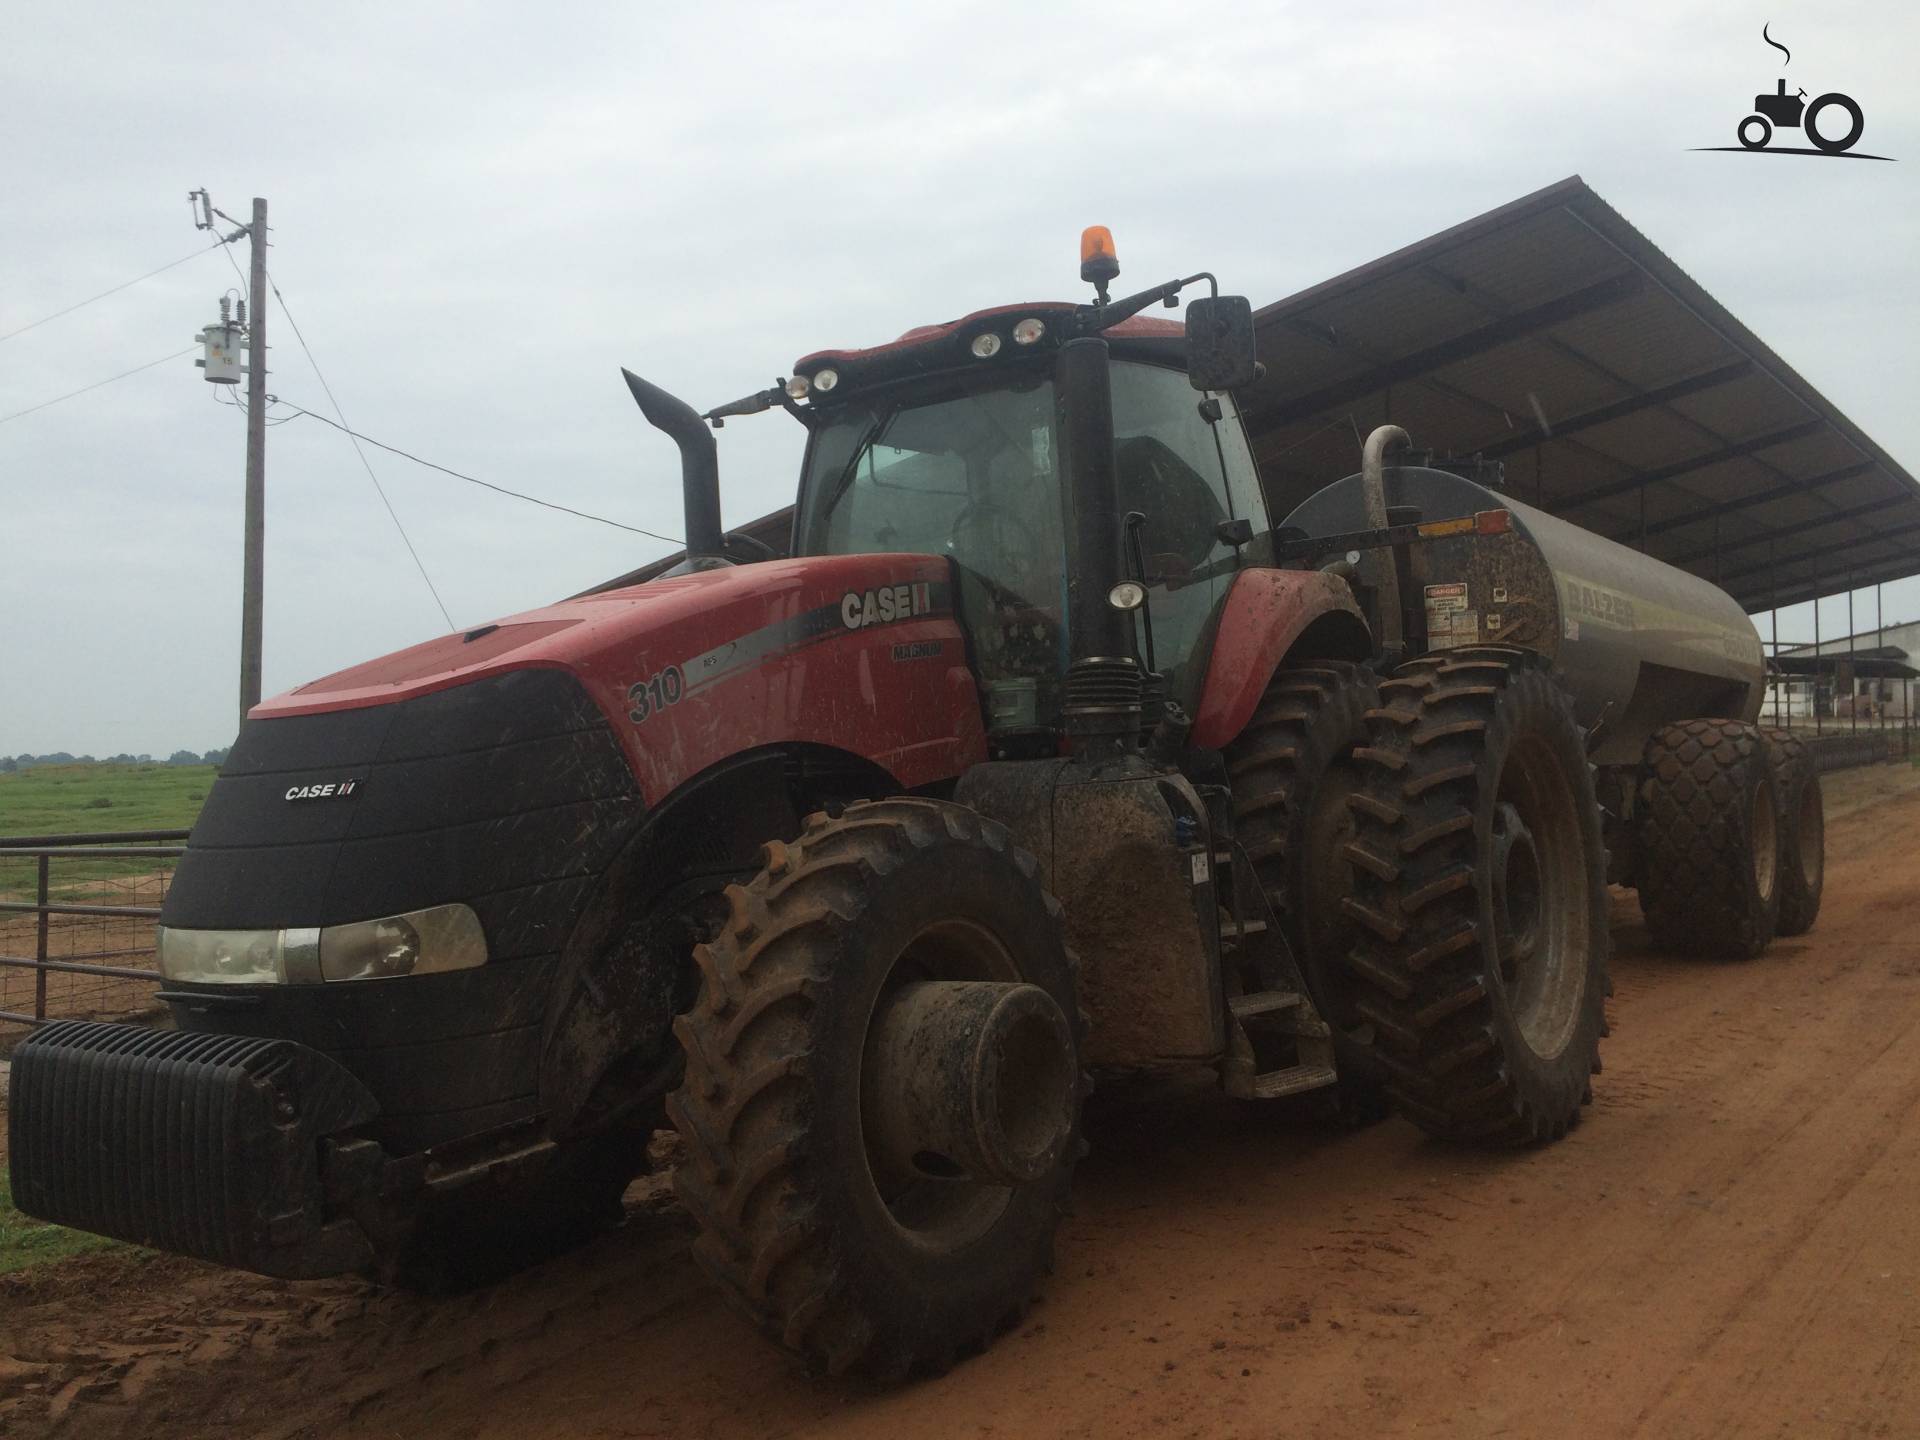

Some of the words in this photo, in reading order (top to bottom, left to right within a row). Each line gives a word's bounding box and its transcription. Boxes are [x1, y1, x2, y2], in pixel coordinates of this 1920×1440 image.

[841, 585, 911, 629] CASE
[628, 665, 682, 724] 310
[285, 783, 336, 800] CASE
